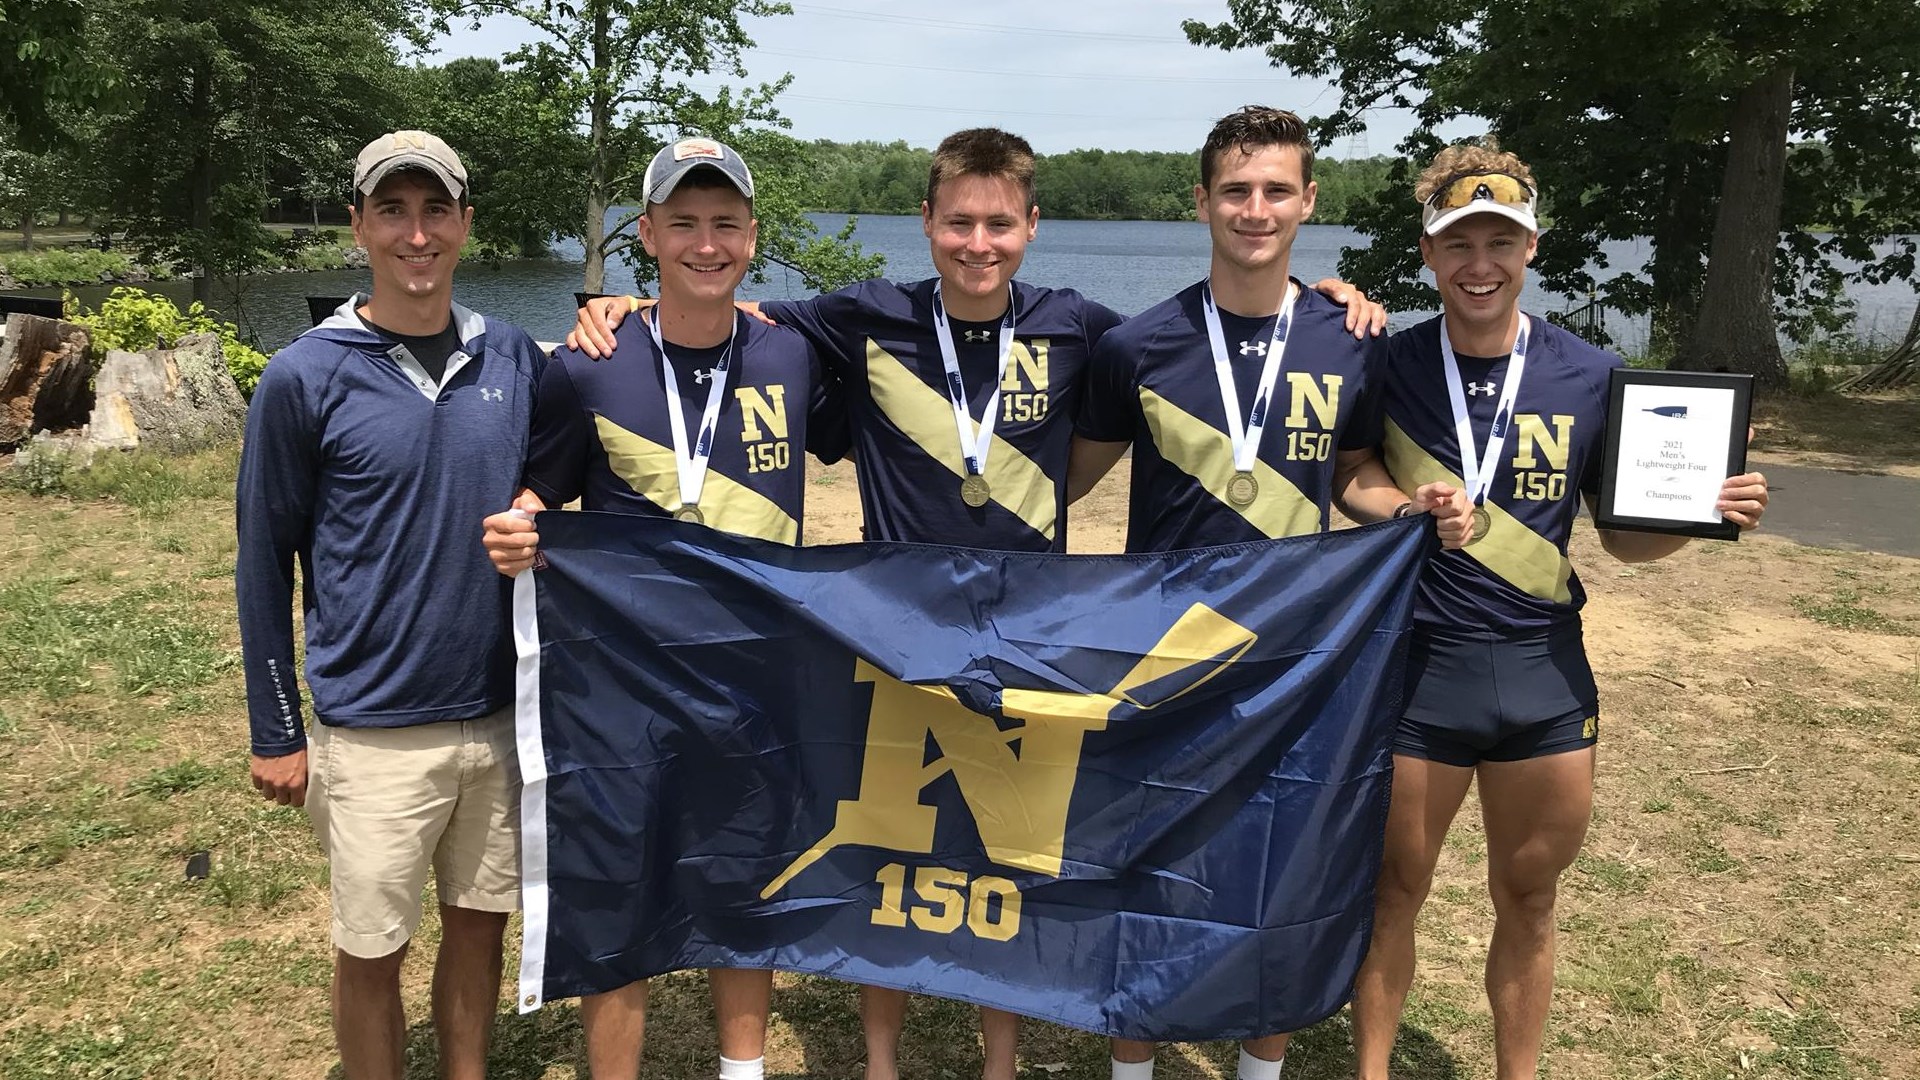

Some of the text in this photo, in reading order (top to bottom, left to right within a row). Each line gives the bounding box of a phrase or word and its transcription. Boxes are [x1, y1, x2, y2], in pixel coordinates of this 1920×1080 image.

[1001, 339, 1050, 391] N
[735, 385, 788, 442] N
[1003, 393, 1049, 422] 150
[1285, 372, 1343, 430] N
[746, 441, 790, 474] 150
[1286, 431, 1332, 462] 150
[1513, 413, 1575, 470] N
[1660, 450, 1686, 459] Men's
[1663, 440, 1683, 449] 2021
[1636, 459, 1708, 471] Lightweight Four
[1513, 472, 1567, 501] 150
[1646, 489, 1692, 501] Champions
[835, 656, 1109, 879] N
[870, 862, 1022, 942] 150
